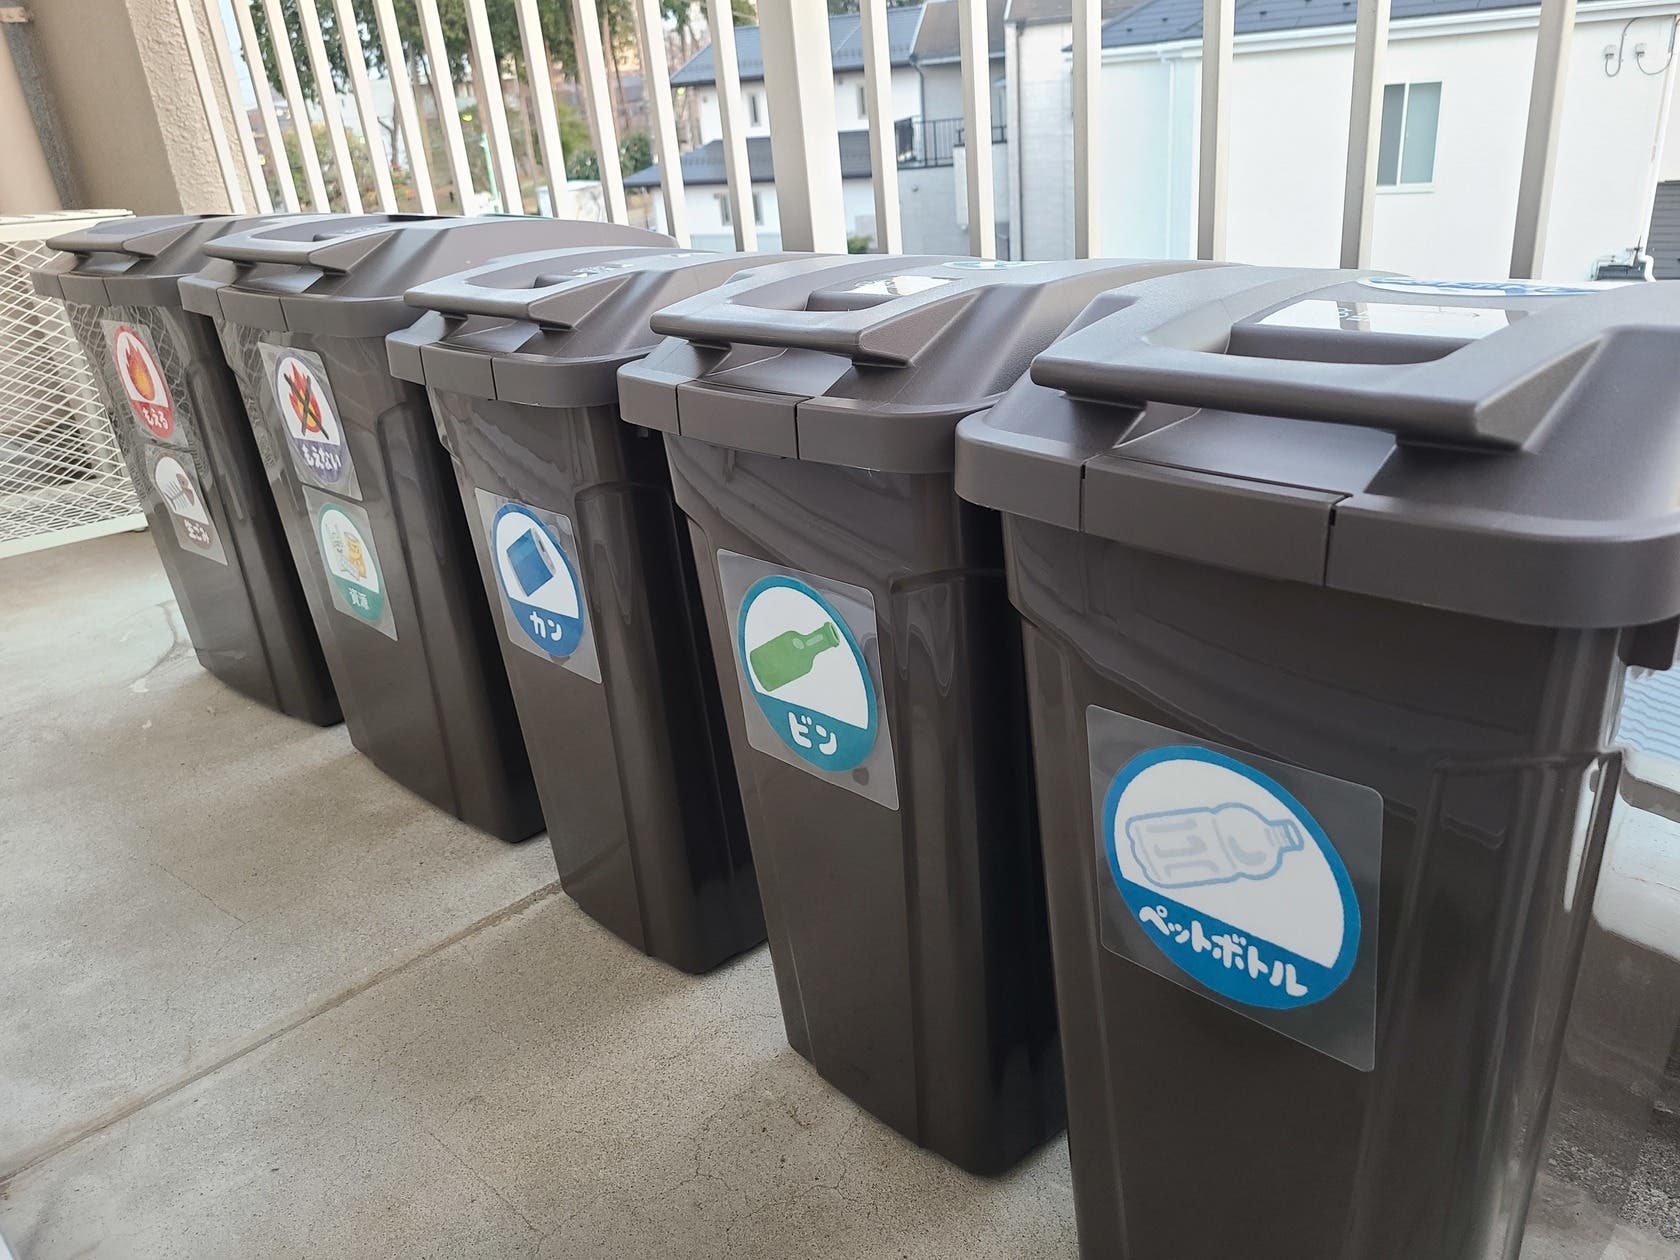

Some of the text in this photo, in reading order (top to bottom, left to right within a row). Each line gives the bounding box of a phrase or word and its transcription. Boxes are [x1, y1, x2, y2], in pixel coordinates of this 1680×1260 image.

[142, 406, 169, 430] もえる
[301, 443, 342, 471] もえない
[184, 518, 210, 544] 生ごみ
[529, 610, 562, 641] カン
[788, 711, 837, 755] ビン
[1139, 905, 1308, 997] ペットボトル
